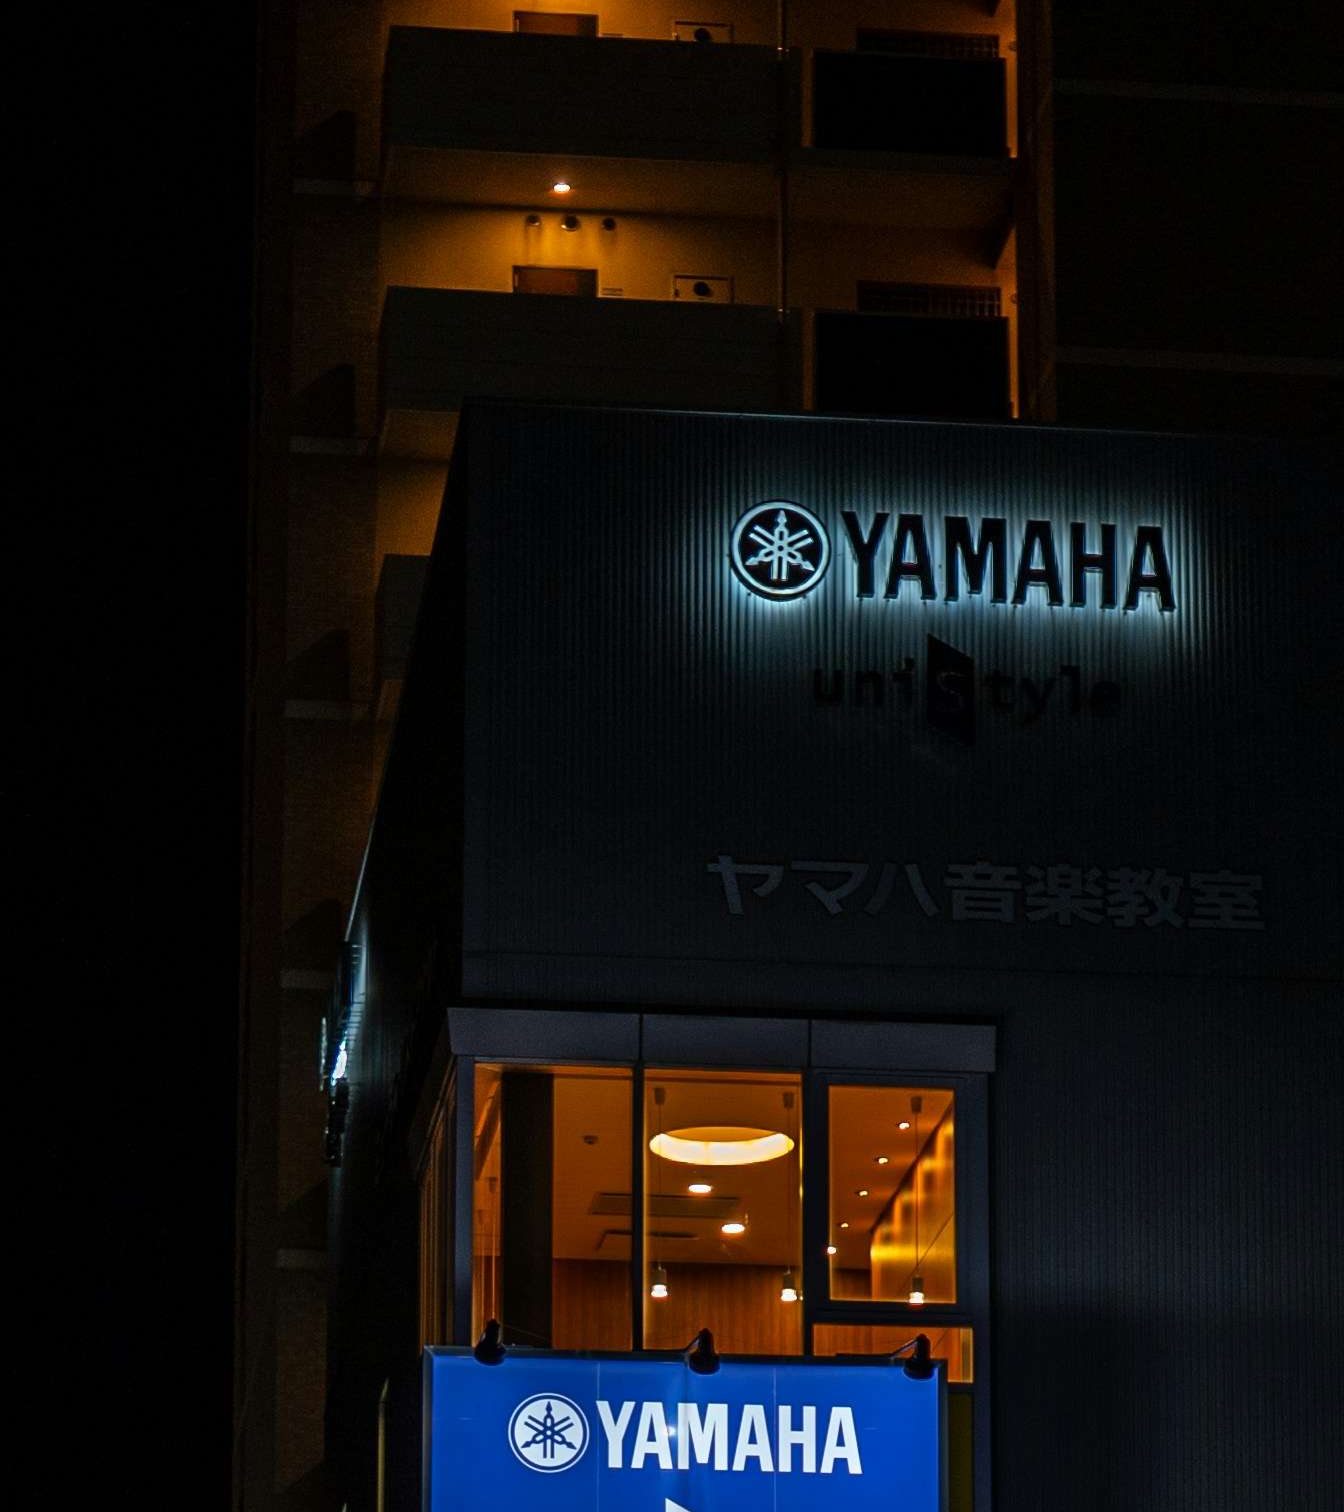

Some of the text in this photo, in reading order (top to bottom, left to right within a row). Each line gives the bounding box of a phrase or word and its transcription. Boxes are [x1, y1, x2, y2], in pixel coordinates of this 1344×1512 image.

[840, 510, 1176, 613] YAMAHA
[812, 648, 1123, 734] uniStyle
[707, 854, 1266, 931] ヤマハ音楽教室
[596, 1399, 863, 1475] YAMAHA
